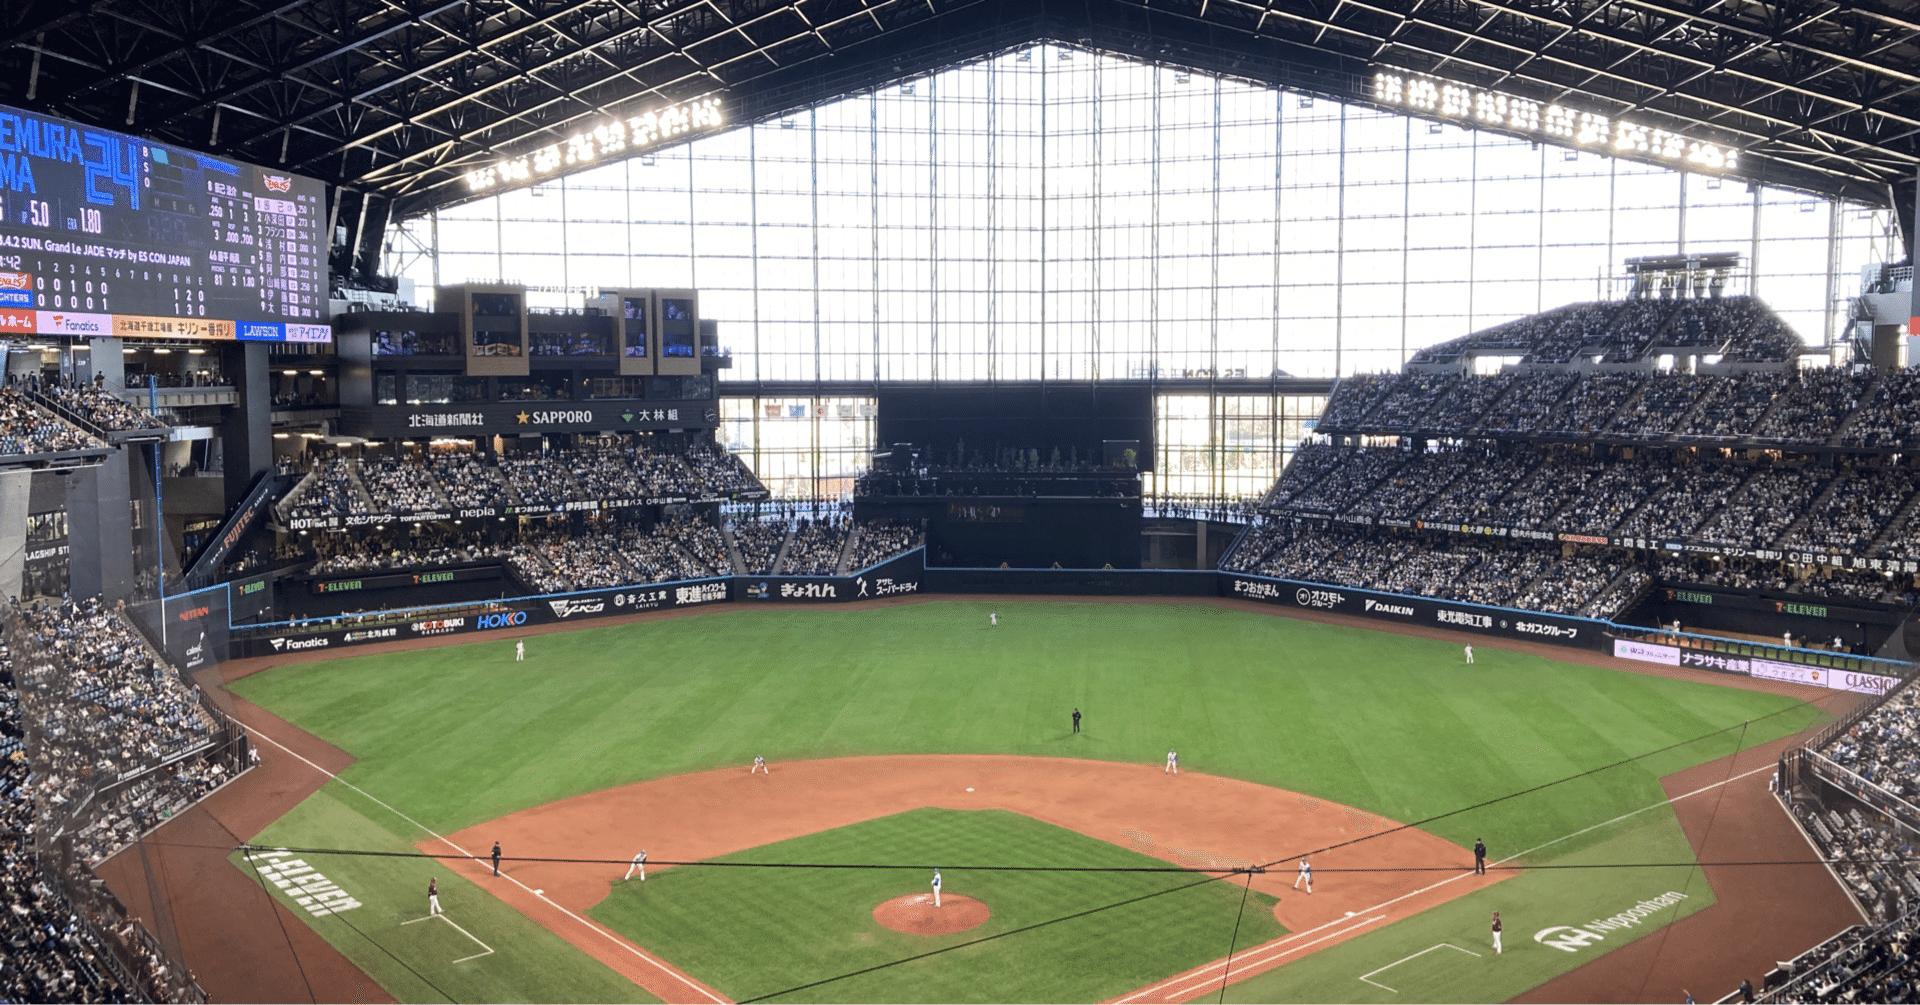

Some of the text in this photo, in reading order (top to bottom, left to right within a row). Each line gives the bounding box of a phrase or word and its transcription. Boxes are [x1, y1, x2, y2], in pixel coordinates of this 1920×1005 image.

[0, 152, 36, 194] MA
[84, 131, 140, 211] 24
[30, 200, 49, 228] 5.0
[80, 207, 101, 234] 1.80
[21, 236, 43, 251] SUN.
[44, 239, 71, 254] Grand
[71, 242, 82, 255] Le
[83, 243, 105, 258] JADE
[106, 246, 126, 260] マッチ
[127, 249, 137, 264] by
[138, 250, 148, 262] ES
[148, 251, 166, 264] CON
[166, 253, 191, 267] JAPAN
[37, 260, 42, 271] 1
[53, 262, 59, 273] 2
[69, 263, 75, 274] 3
[85, 265, 91, 275] 4
[100, 266, 106, 277] 5
[115, 268, 120, 278] 6
[129, 269, 135, 280] 7
[143, 271, 149, 281] 8
[157, 272, 162, 282] 9
[37, 276, 204, 302] 0 0 1 0 0 1 2 0
[38, 293, 45, 307] 0
[54, 294, 62, 308] 0
[70, 296, 78, 309] 0
[86, 297, 93, 310] 0
[102, 297, 107, 310] 1
[174, 302, 179, 315] 1
[186, 303, 192, 316] 3
[198, 304, 205, 316] 0
[65, 318, 99, 332] Fanatics
[243, 324, 279, 337] LAWSON
[408, 413, 484, 427] 北海道新聞社
[532, 410, 593, 425] SAPPORO
[639, 409, 679, 422] 大林組
[514, 505, 551, 514] まつおかまん
[609, 499, 643, 508] 北海道バス
[460, 506, 496, 518] nepia
[223, 505, 255, 549] FUJITEC
[290, 518, 313, 530] HOT
[1623, 538, 1659, 550] 関電工
[1723, 547, 1783, 560] キリン一番搾り
[1802, 553, 1843, 566] 田中組
[876, 578, 893, 586] アサヒ
[876, 582, 918, 595] スーパードライ
[1234, 580, 1280, 597] まつおかまん
[676, 586, 701, 605] 東進
[780, 583, 837, 598] ぎょれん
[1311, 590, 1346, 603] オカモト
[1311, 600, 1334, 608] グループ
[1374, 602, 1415, 616] DAIKIN
[419, 617, 464, 631] KOTOBUKI
[477, 611, 527, 629] HOKKO
[1515, 621, 1578, 638] 北ガスグループ
[286, 637, 328, 650] Fanatics
[1582, 890, 1689, 934] Nipponham
